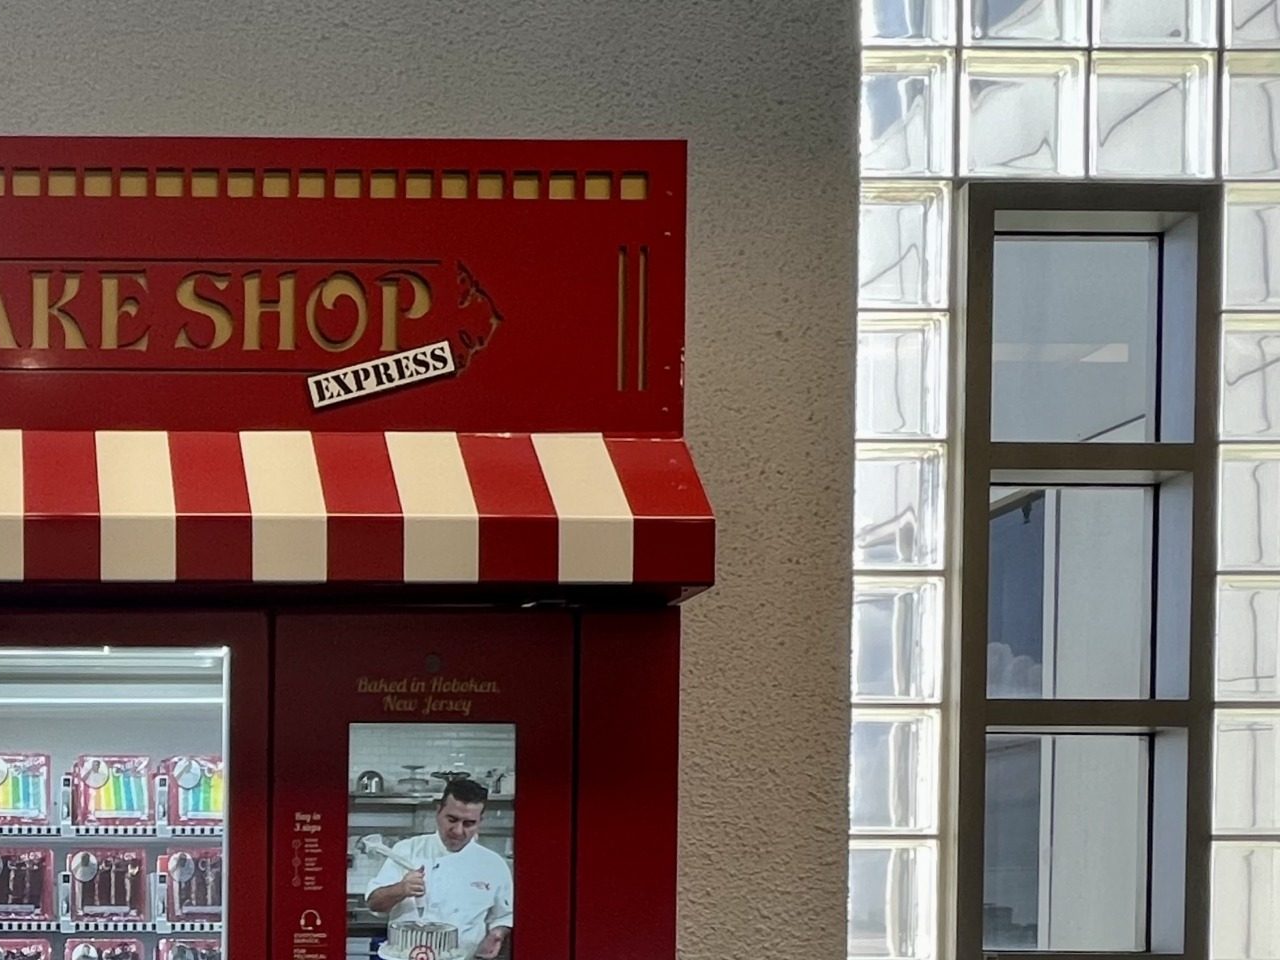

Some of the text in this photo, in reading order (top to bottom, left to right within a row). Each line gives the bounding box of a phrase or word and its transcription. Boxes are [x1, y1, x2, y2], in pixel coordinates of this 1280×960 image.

[174, 268, 433, 352] SHOP
[312, 346, 449, 403] EXPRESS
[357, 676, 407, 693] Baked
[410, 677, 425, 693] in
[383, 696, 472, 716] New Jersey
